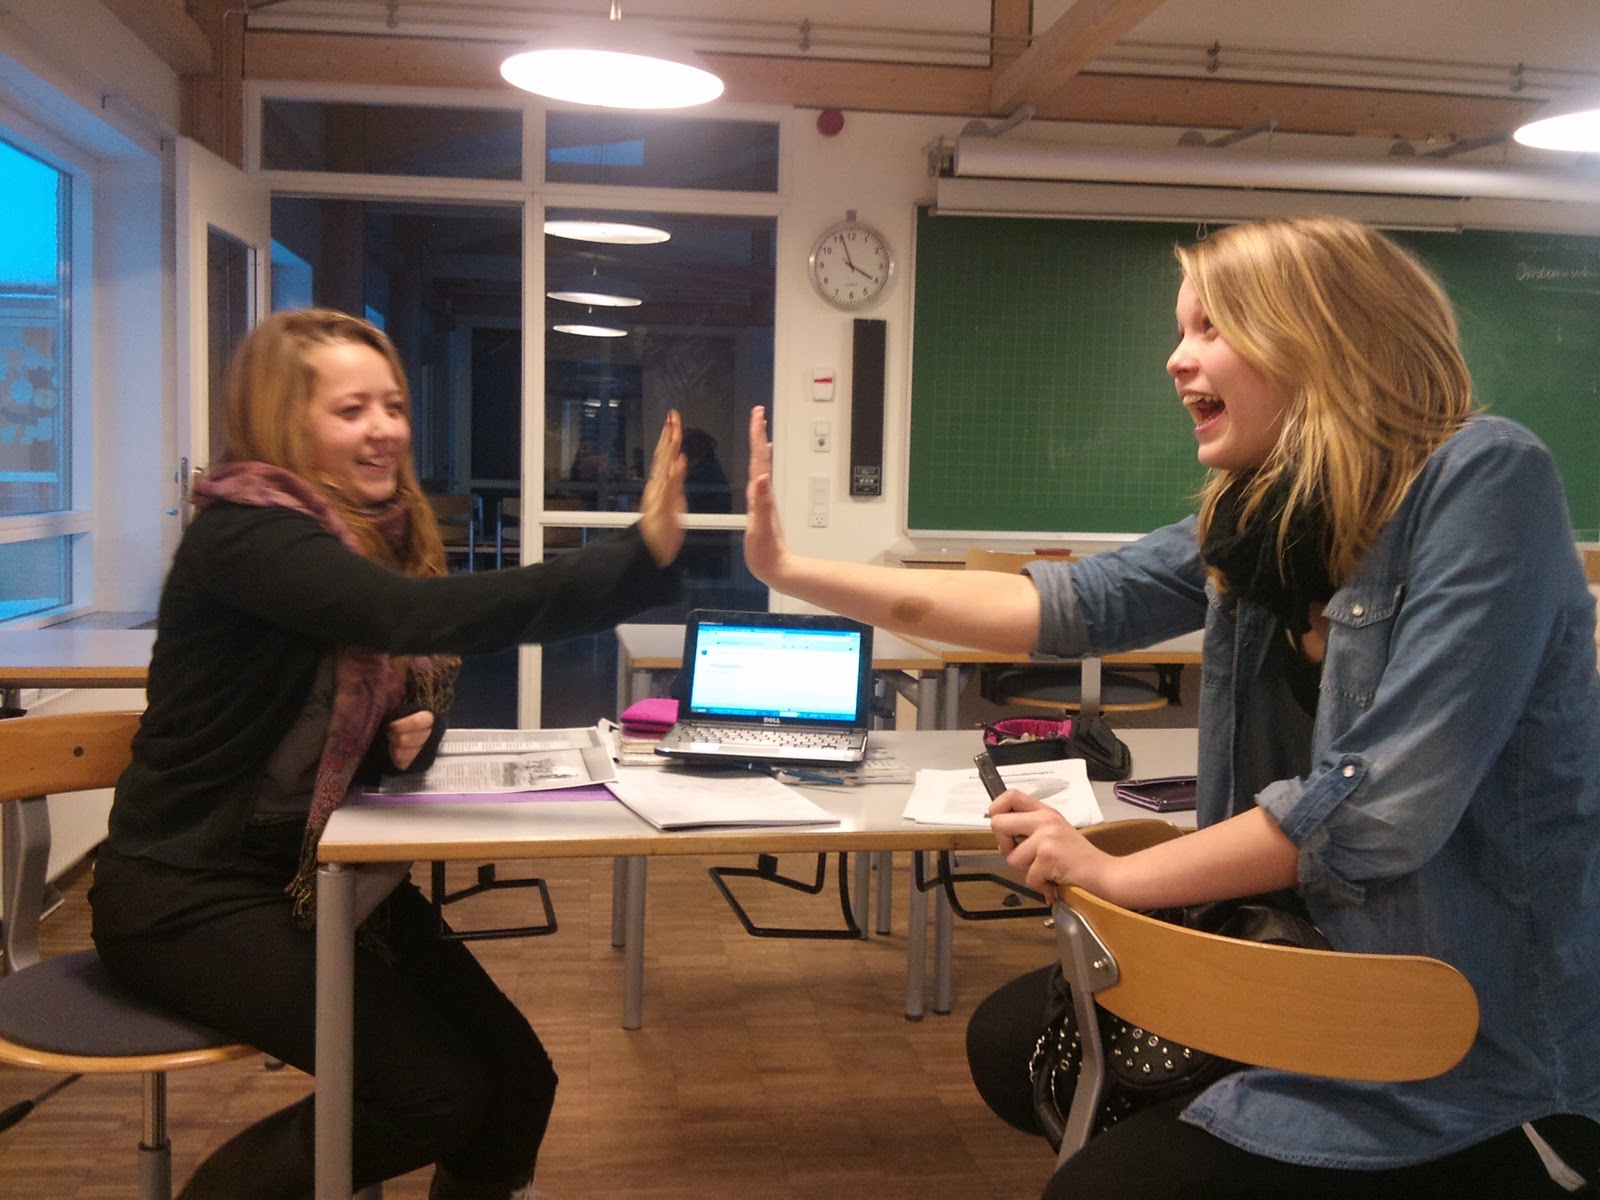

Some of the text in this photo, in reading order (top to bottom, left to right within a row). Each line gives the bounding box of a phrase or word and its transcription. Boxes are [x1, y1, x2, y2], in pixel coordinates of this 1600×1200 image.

[848, 232, 857, 241] 12
[823, 247, 832, 255] 10
[824, 276, 829, 285] 8
[849, 291, 854, 300] 6
